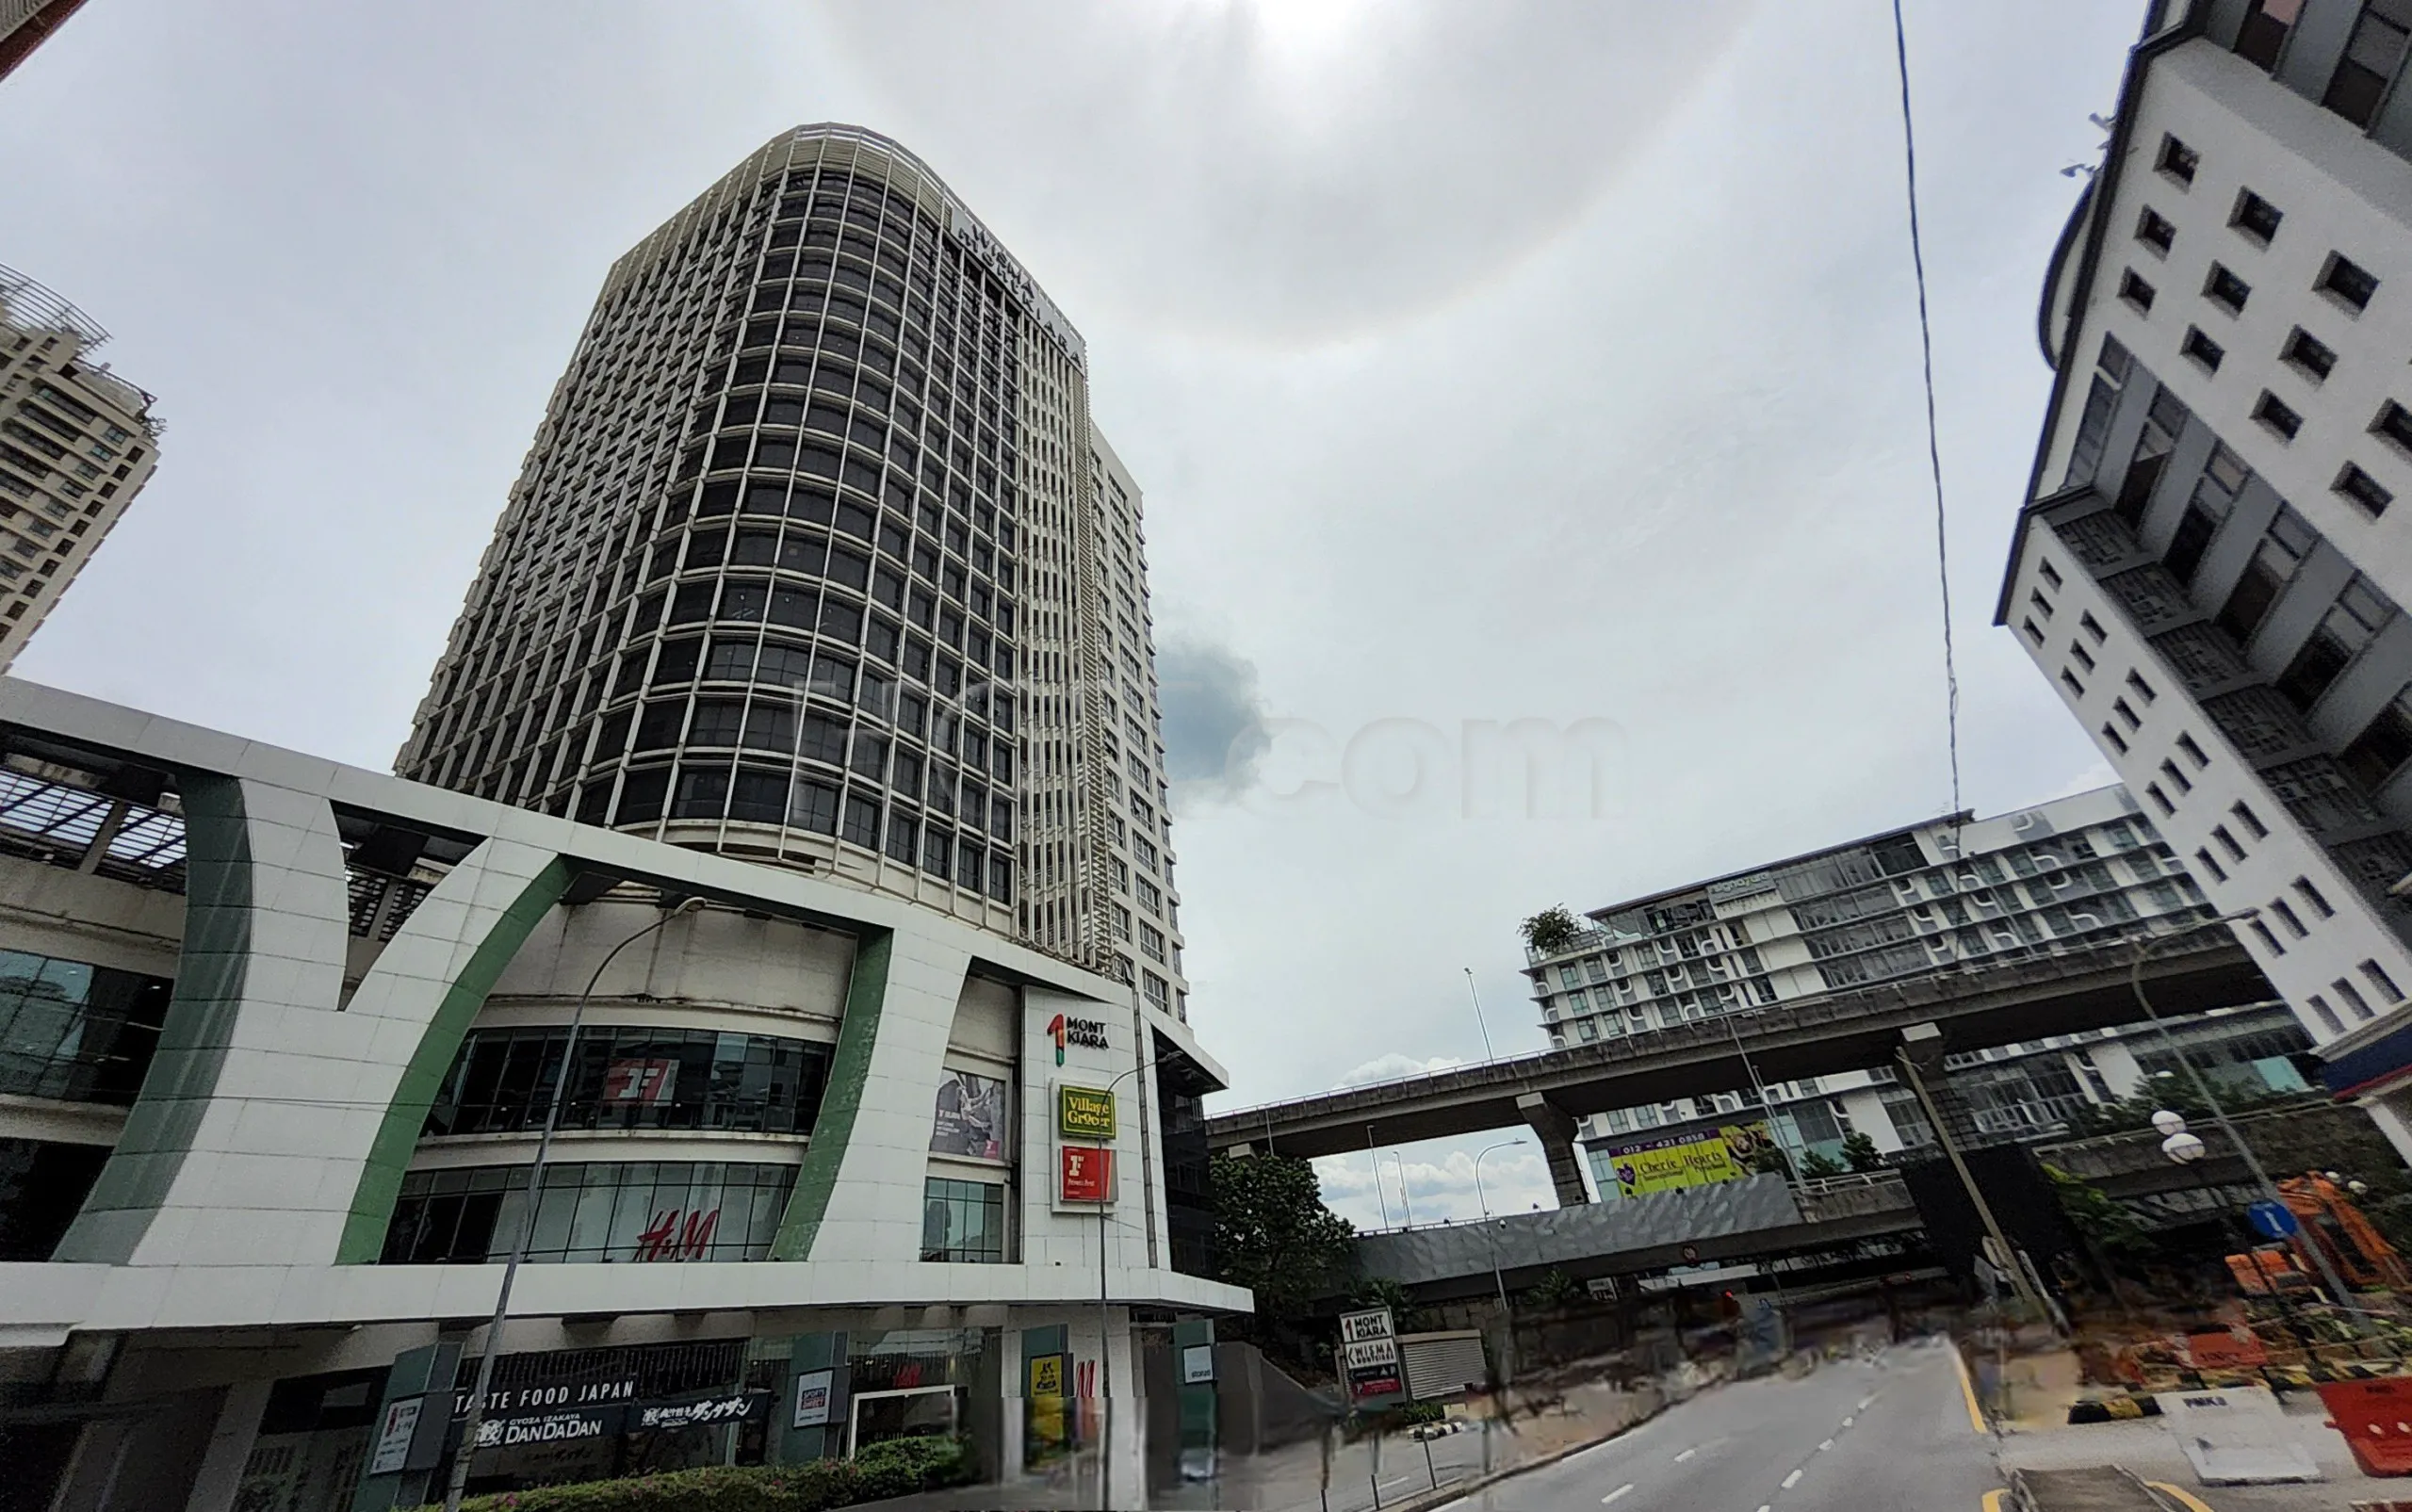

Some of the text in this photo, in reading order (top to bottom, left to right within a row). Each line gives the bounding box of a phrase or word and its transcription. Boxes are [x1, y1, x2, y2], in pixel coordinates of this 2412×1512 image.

[1066, 1016, 1106, 1035] MONT
[1066, 1030, 1111, 1051] KIARA
[1067, 1096, 1110, 1116] Village
[632, 1209, 720, 1261] H&M
[1354, 1314, 1383, 1326] MONT
[1357, 1324, 1388, 1338] KIARA
[1354, 1341, 1394, 1357] WISMA
[519, 1387, 569, 1407] FOOD
[578, 1380, 635, 1403] JAPAN
[509, 1412, 581, 1426] GYOZA IZAKAYA
